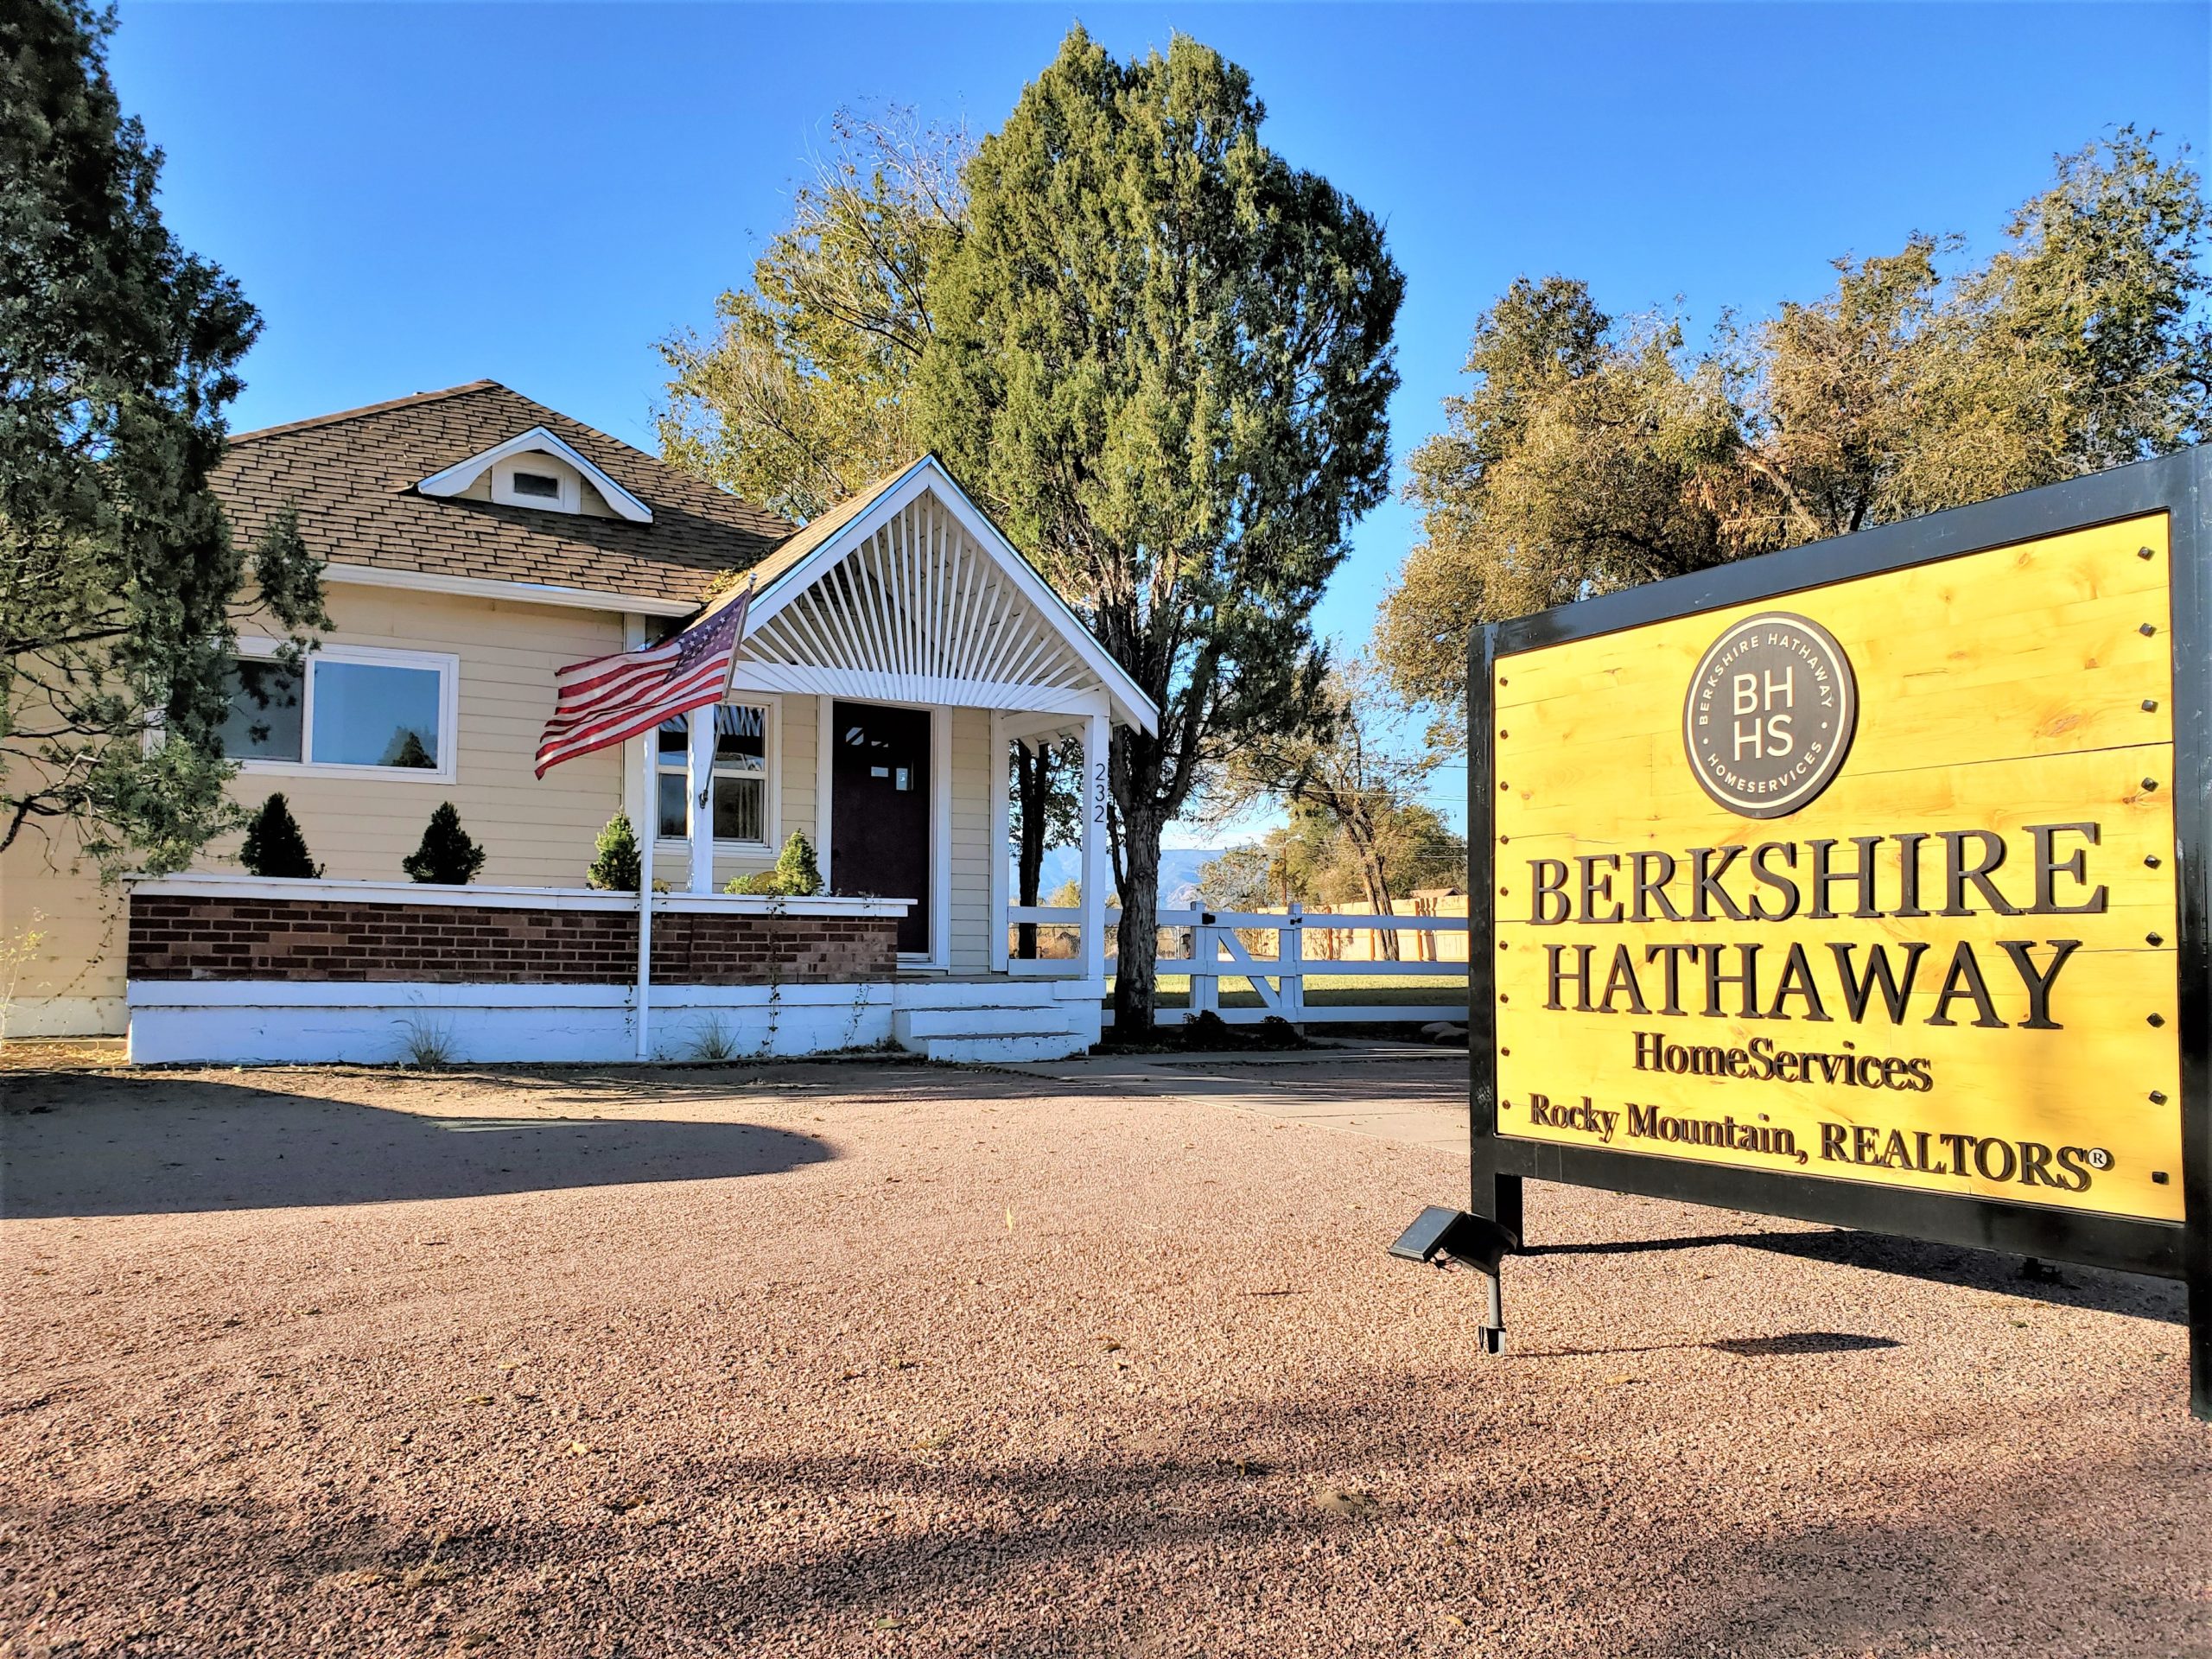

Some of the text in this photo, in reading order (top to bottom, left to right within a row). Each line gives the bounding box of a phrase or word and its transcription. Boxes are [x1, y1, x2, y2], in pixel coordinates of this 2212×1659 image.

[1699, 633, 1833, 726] BERKSHIRE HATHAWAY
[1733, 666, 1793, 715] BH
[1707, 741, 1822, 793] HOMESERVICES
[1733, 714, 1794, 761] HS
[1094, 763, 1106, 823] 232
[1526, 822, 2108, 925] BERKSHIRE
[1542, 939, 2083, 1030] HATHAWAY
[1632, 1031, 1934, 1093] HomeServices
[1529, 1092, 1620, 1145] Rocky
[1625, 1103, 1808, 1166] Mountain,
